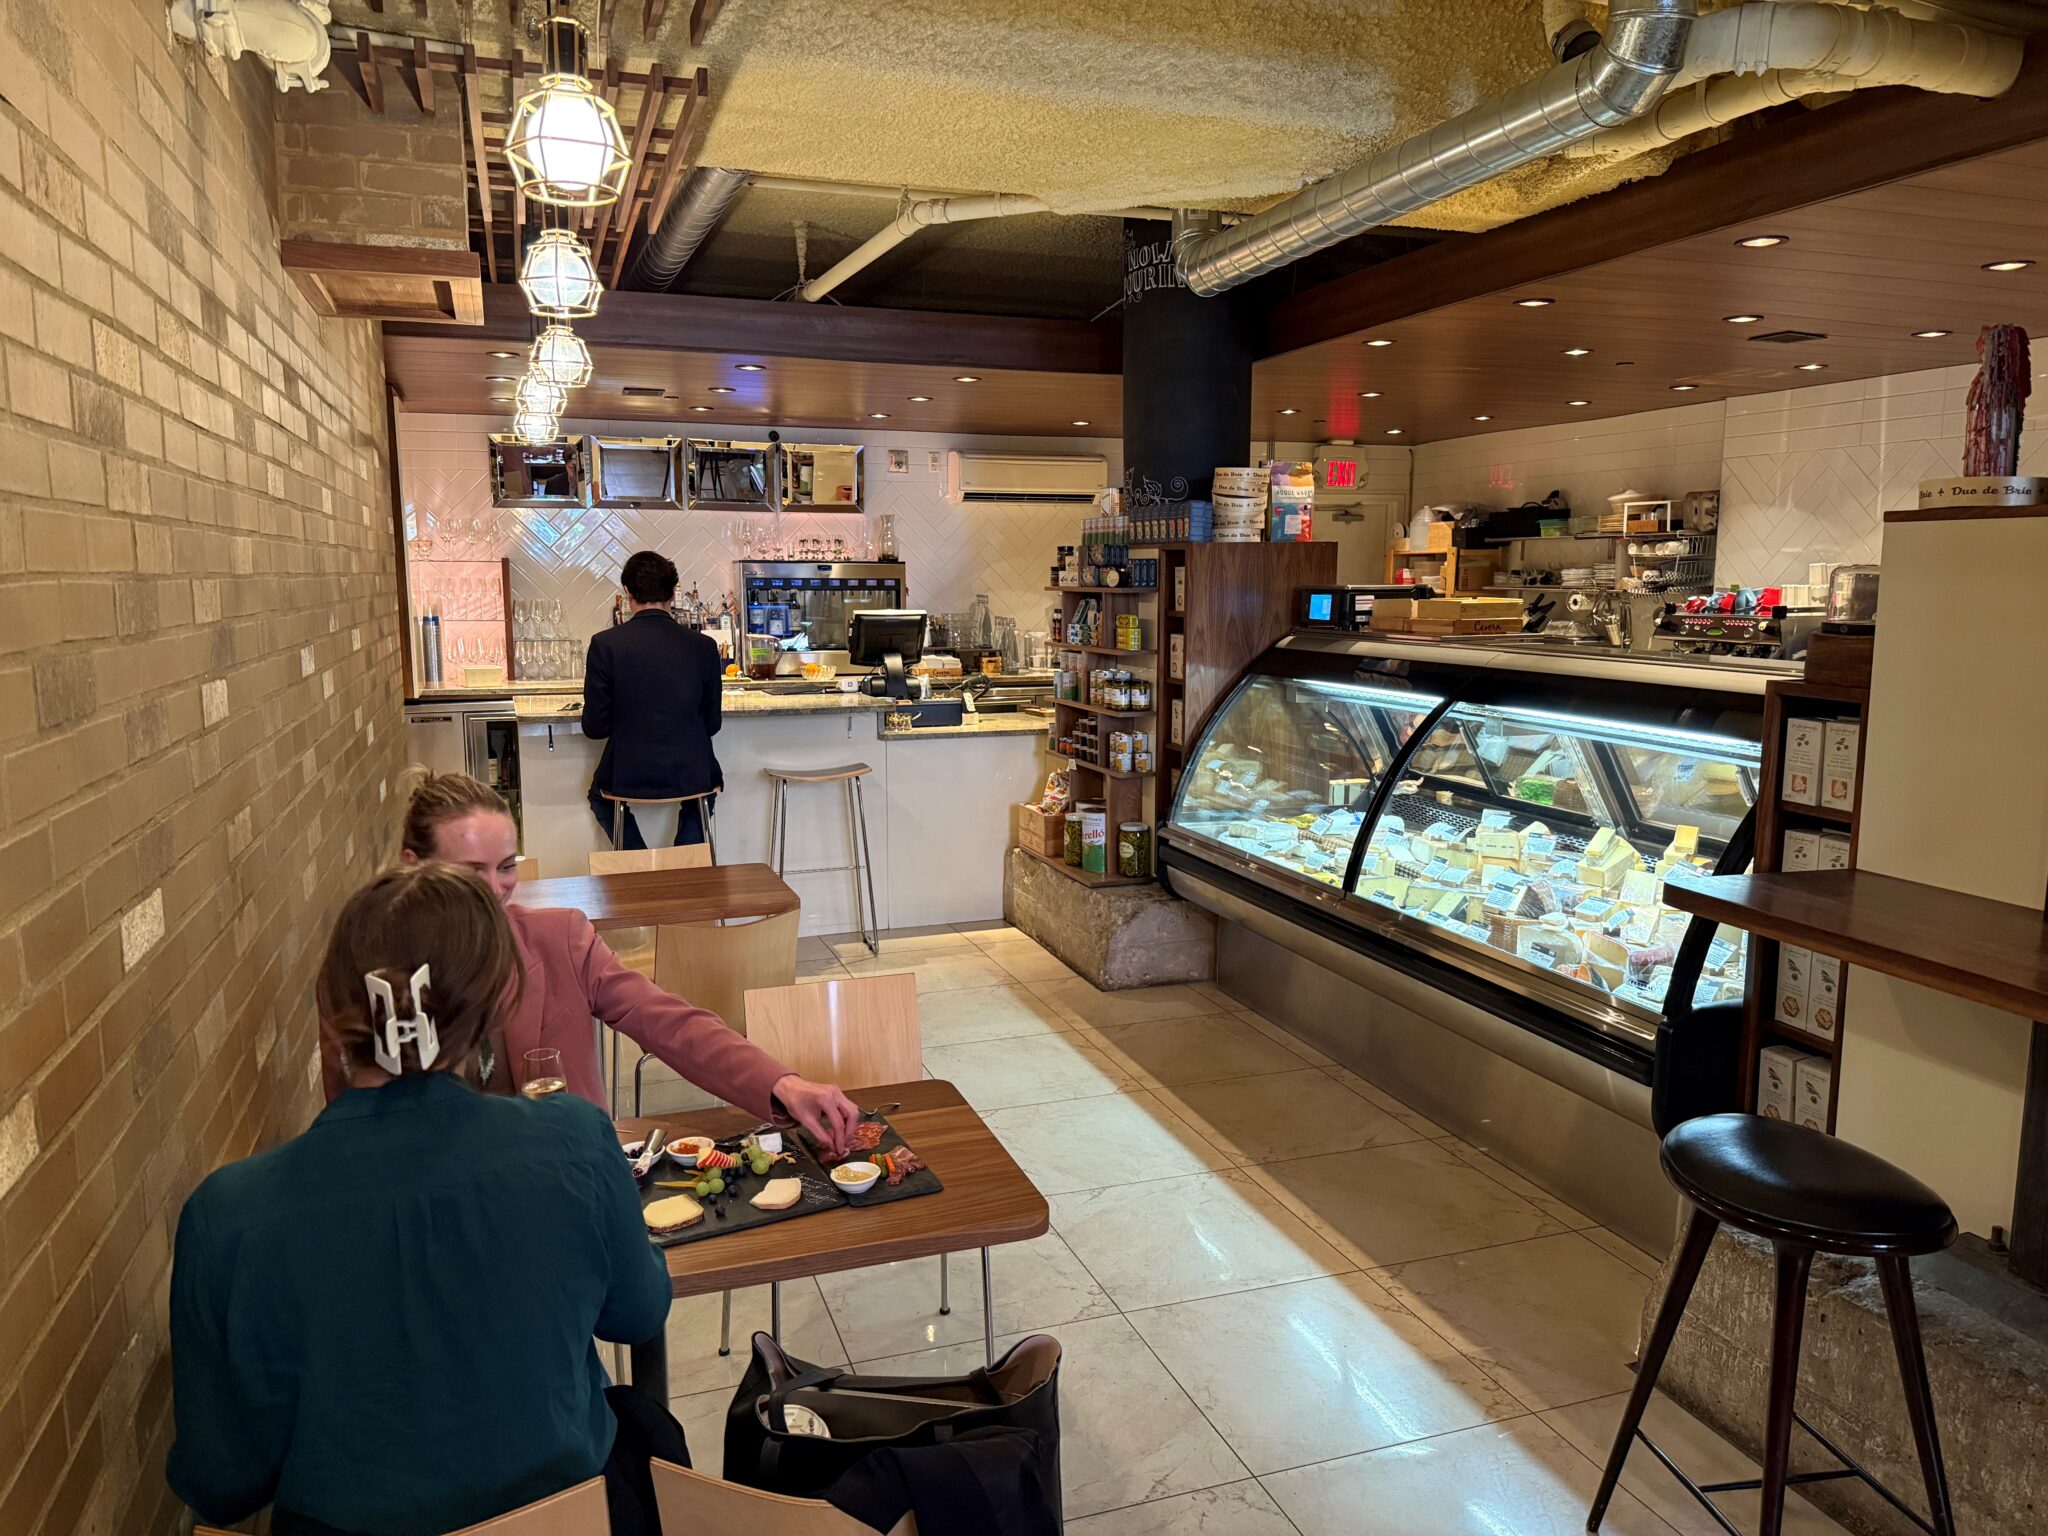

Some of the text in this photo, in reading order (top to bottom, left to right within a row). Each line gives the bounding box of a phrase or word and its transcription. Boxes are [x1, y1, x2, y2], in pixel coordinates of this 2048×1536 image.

[1127, 241, 1173, 272] NOW
[1327, 461, 1357, 487] EXIT
[1951, 485, 2033, 496] Duo de Brie
[1473, 620, 1503, 632] Cavern
